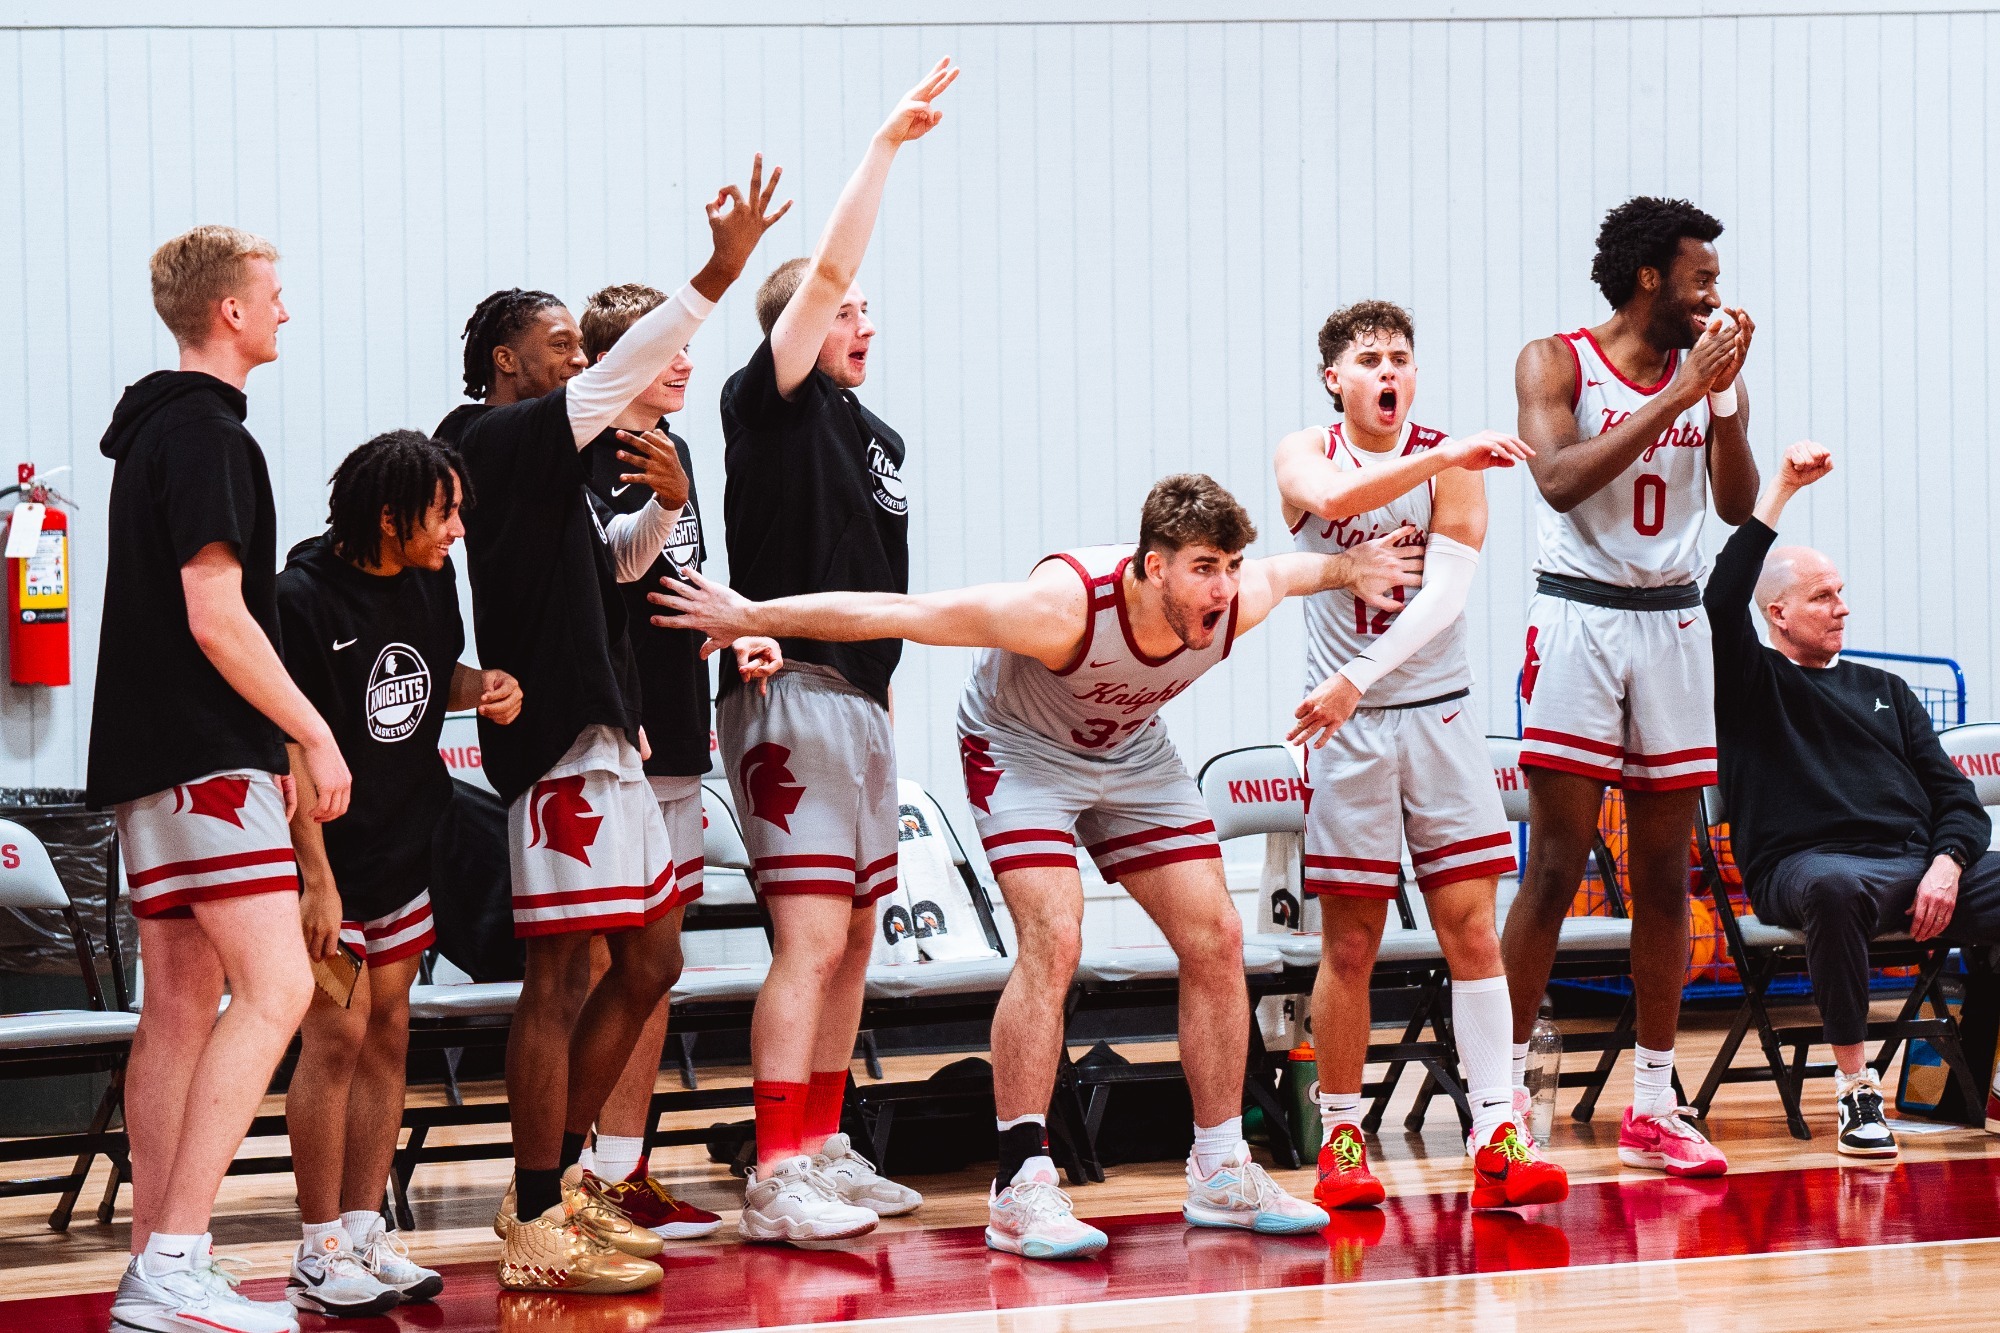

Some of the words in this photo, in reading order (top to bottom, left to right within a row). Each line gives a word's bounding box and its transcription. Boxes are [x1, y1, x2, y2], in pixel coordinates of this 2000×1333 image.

[1634, 473, 1666, 536] 0
[1073, 679, 1194, 715] Knight
[374, 717, 417, 737] BASKETBALL
